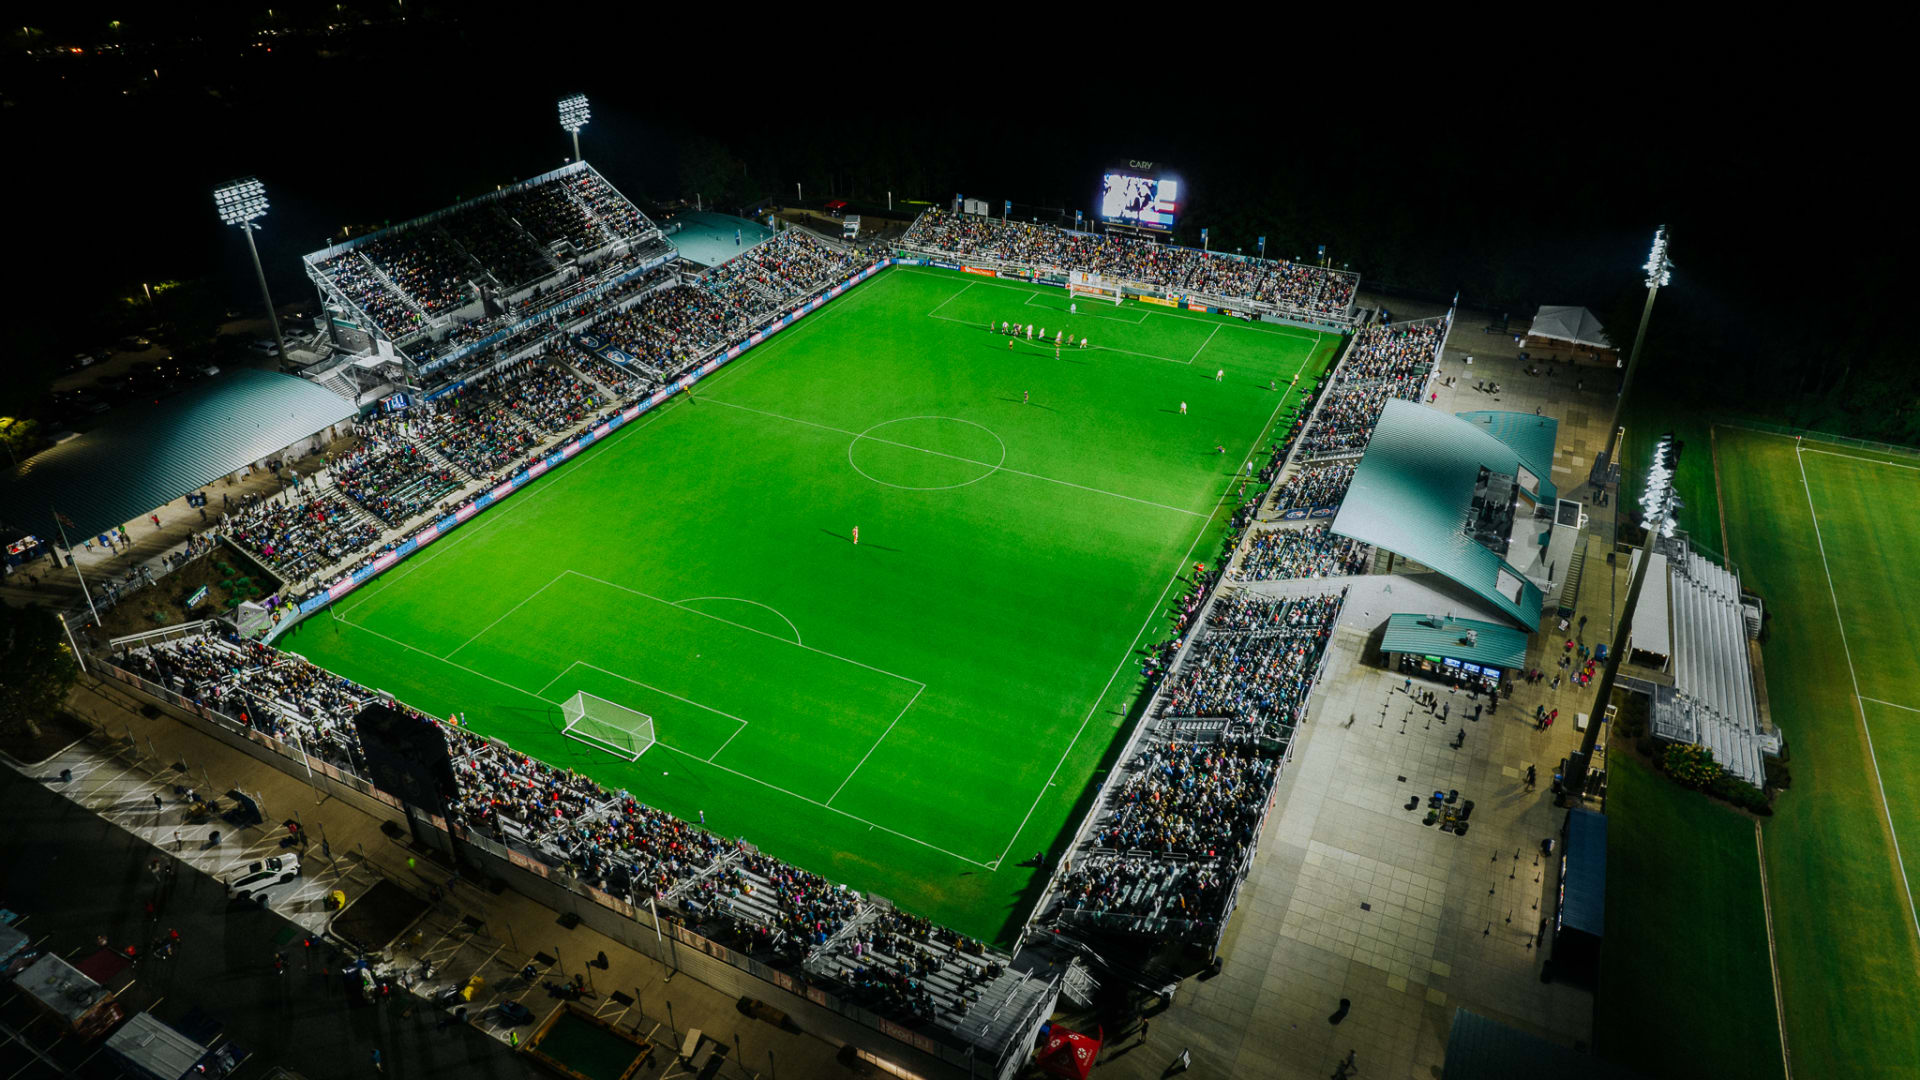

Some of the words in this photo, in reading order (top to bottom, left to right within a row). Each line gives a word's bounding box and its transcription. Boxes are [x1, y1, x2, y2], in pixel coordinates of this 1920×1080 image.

[1129, 160, 1152, 169] CARY
[549, 302, 567, 317] NORTH
[567, 290, 591, 308] CAROLINA
